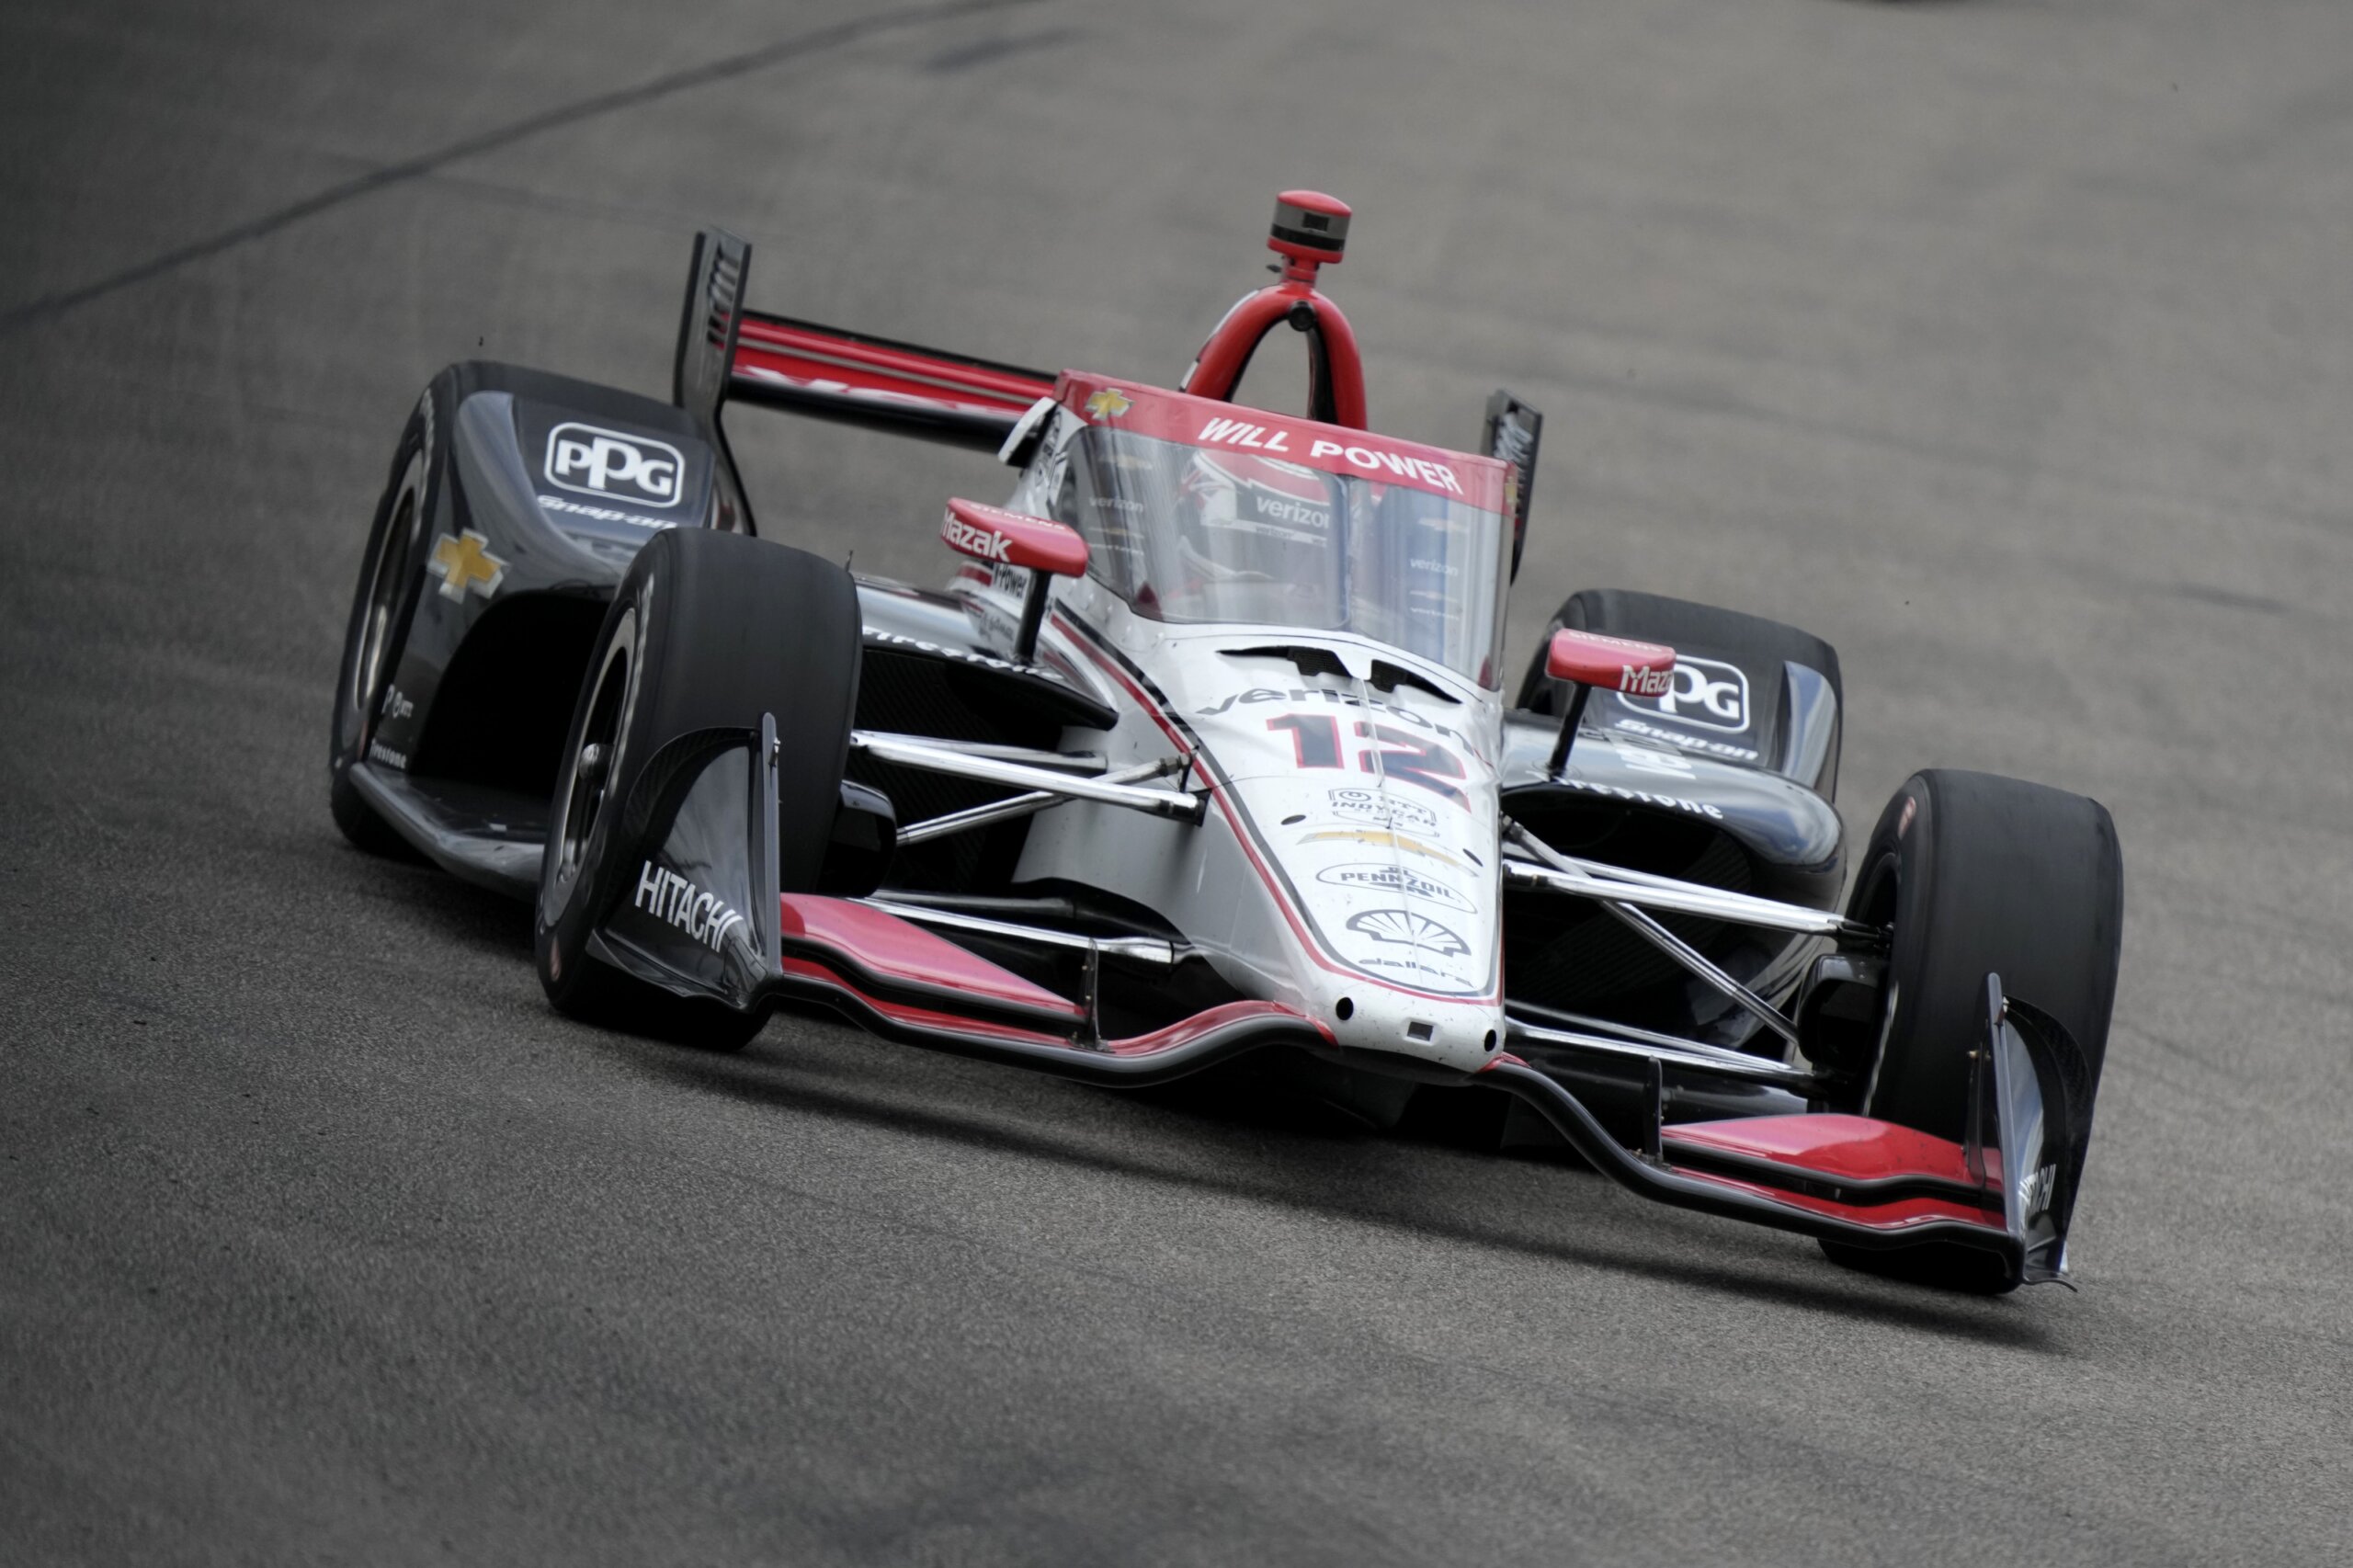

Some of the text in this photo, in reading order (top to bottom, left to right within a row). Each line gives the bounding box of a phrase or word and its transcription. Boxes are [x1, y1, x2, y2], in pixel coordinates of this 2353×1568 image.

[555, 437, 675, 491] PPG
[1198, 417, 1463, 494] WILL POWER
[941, 507, 1013, 563] Mazak
[970, 503, 1066, 531] SIEMENS
[1568, 631, 1663, 653] SIEMENS
[1657, 664, 1741, 721] PG
[1196, 687, 1475, 757] verizon
[1266, 713, 1472, 813] 12
[634, 859, 744, 953] HITACHI
[1340, 872, 1456, 902] PENNZOIL
[1358, 958, 1475, 990] dallara
